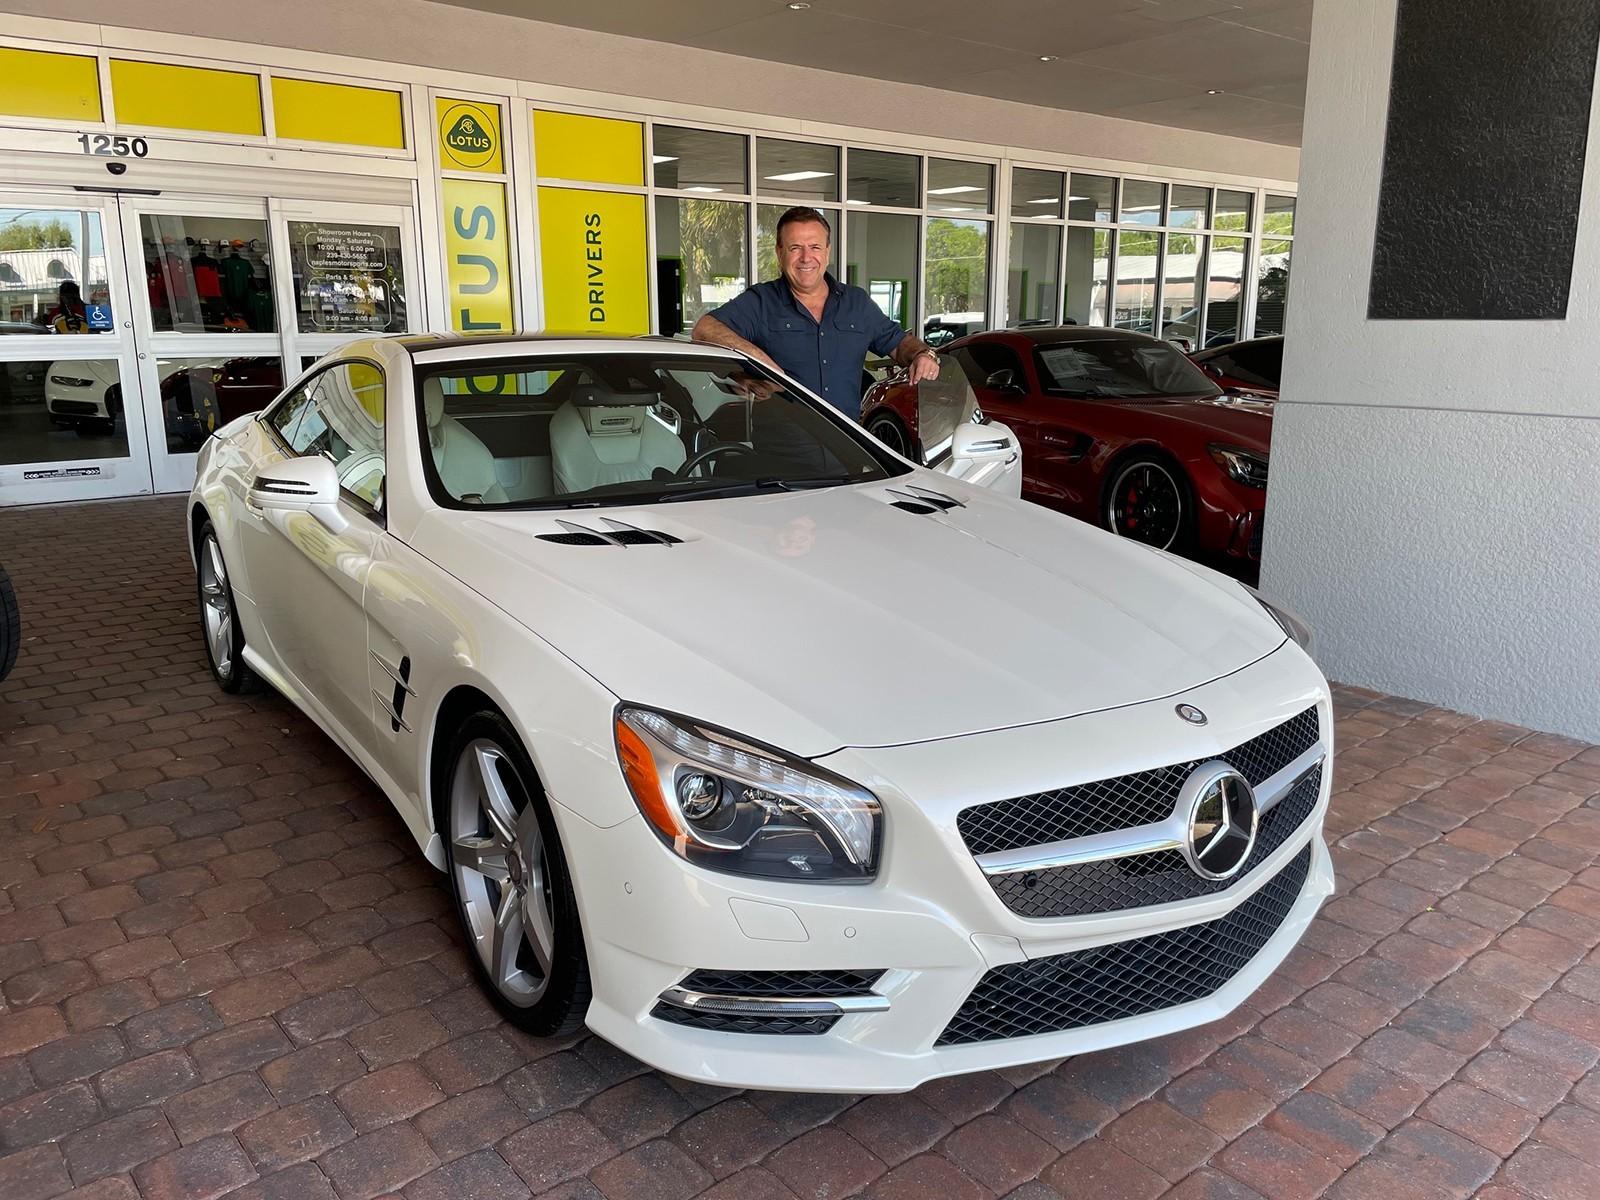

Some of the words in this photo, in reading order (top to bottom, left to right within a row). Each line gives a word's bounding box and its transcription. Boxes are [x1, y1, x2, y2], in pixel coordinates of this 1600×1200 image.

[77, 134, 148, 158] 1250
[450, 134, 489, 148] LOTUS
[318, 228, 351, 236] Showroom
[317, 236, 341, 244] Monday
[346, 237, 374, 245] Saturday
[311, 260, 383, 268] naplesmotorsports.com
[584, 213, 606, 322] DRIVERS
